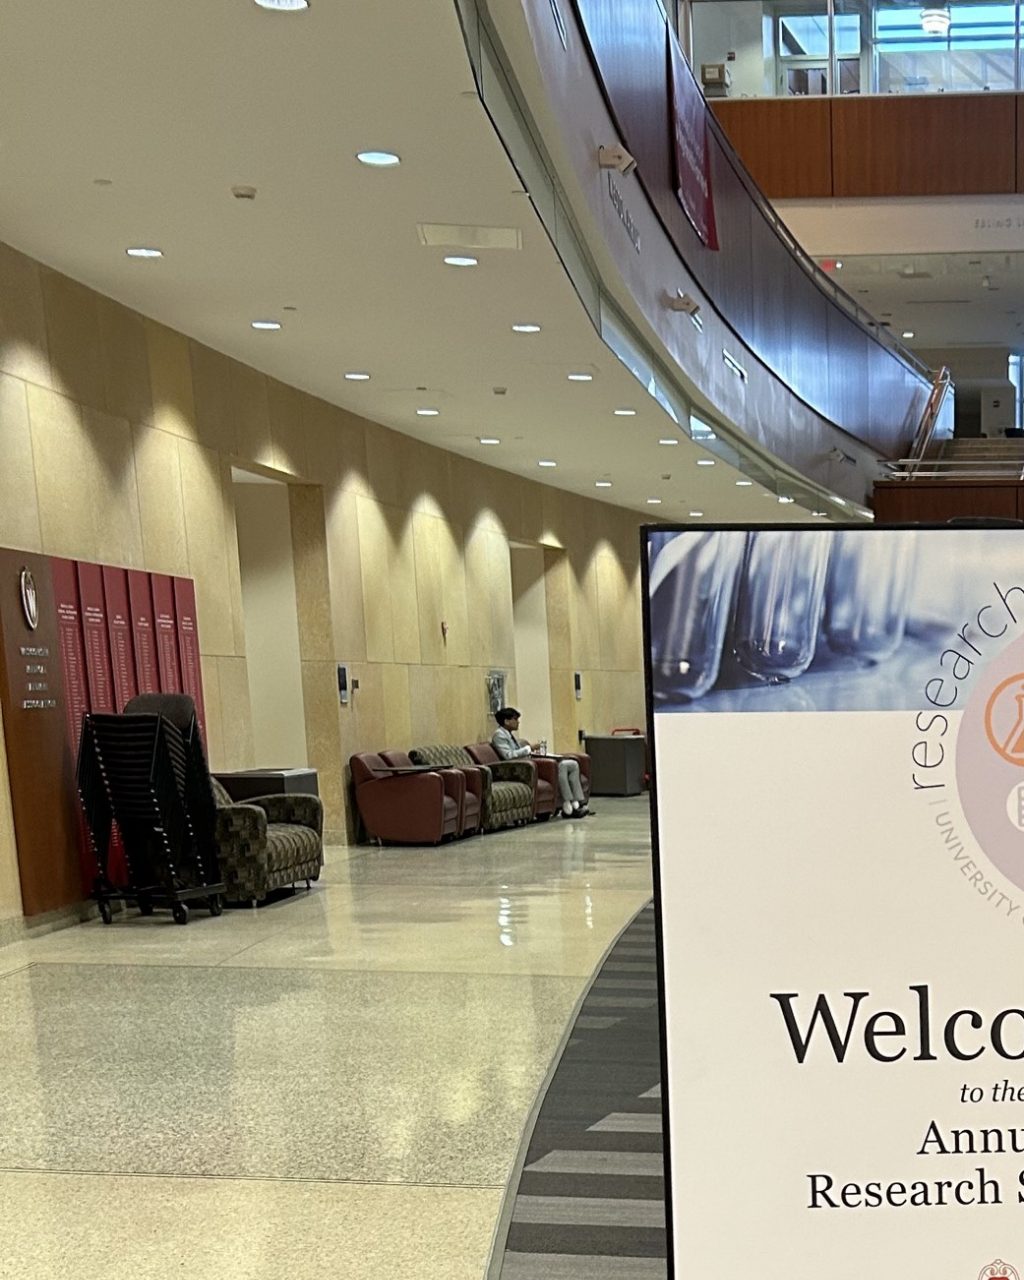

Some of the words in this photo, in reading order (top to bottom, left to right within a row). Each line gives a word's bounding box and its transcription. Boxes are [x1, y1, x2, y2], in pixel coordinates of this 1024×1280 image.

[935, 812, 1021, 918] UNIVERSITY
[959, 1083, 985, 1104] to
[805, 1168, 1004, 1209] Research
